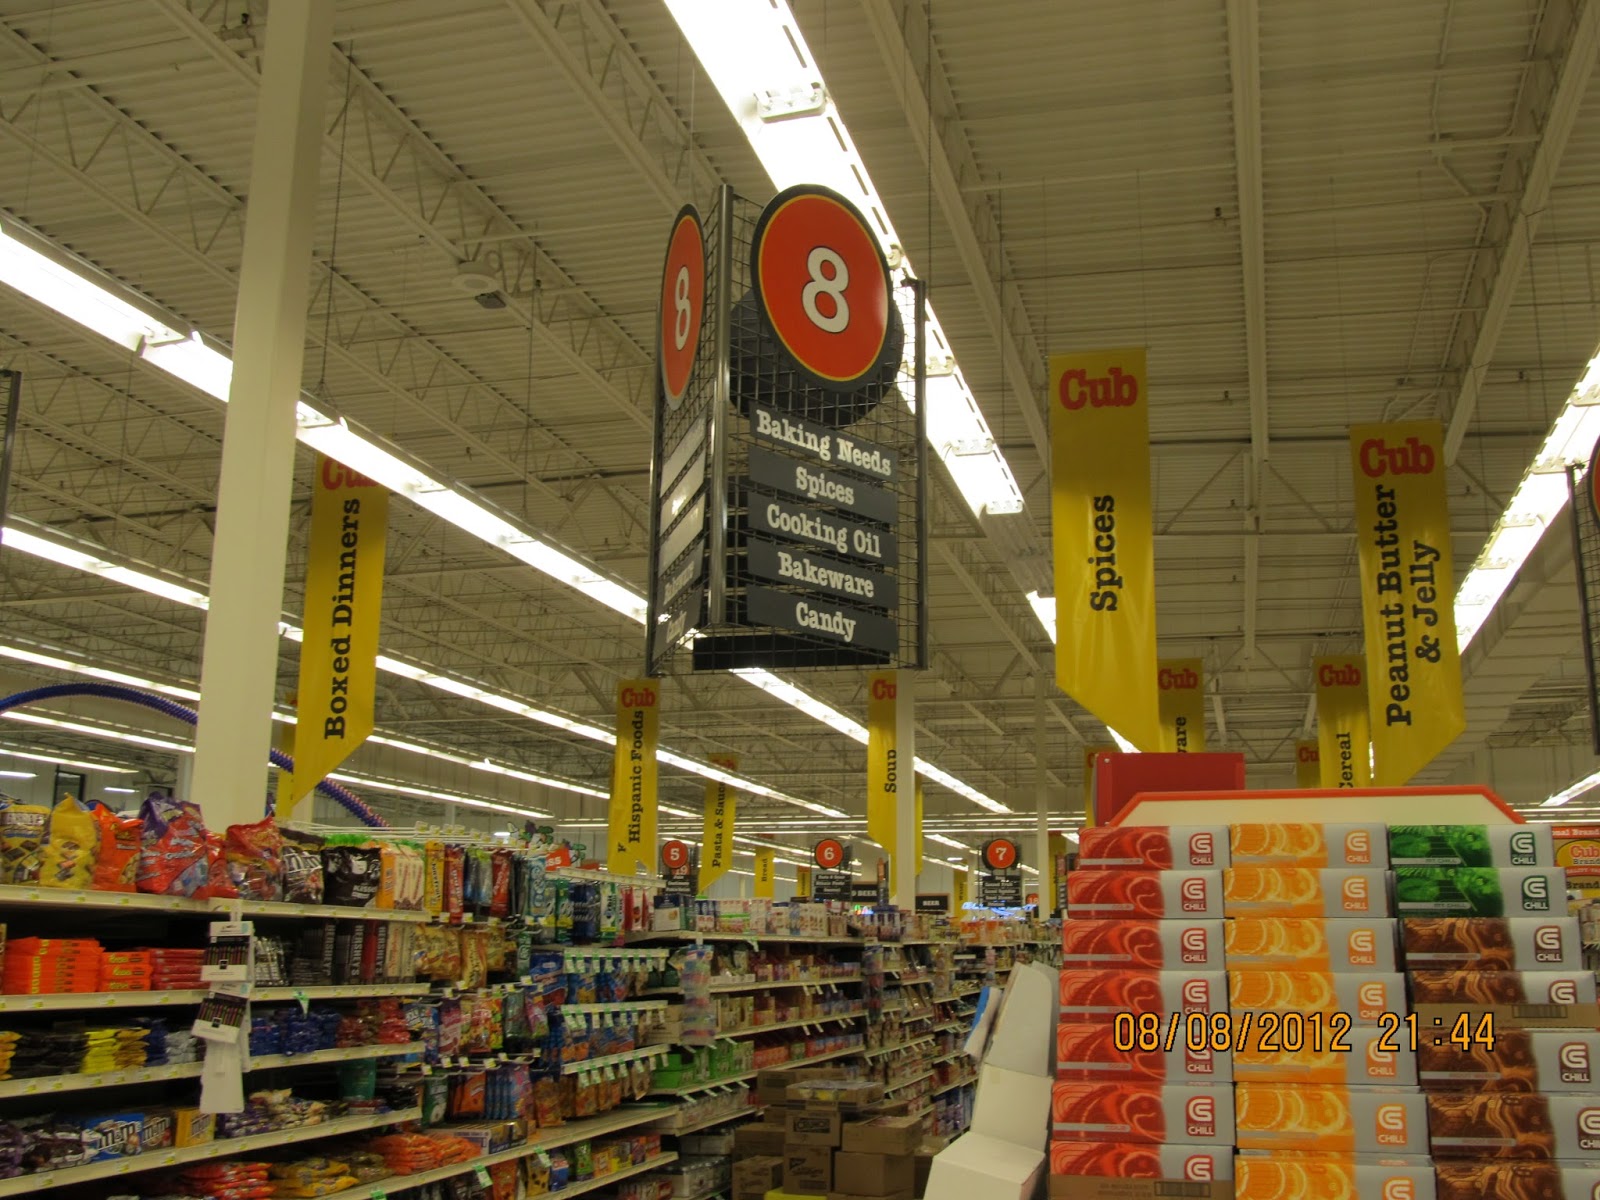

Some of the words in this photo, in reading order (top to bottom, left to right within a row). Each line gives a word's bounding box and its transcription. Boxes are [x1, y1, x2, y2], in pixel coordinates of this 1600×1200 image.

[802, 246, 850, 334] 8
[674, 265, 692, 351] 8
[1058, 366, 1139, 411] Cub
[756, 409, 831, 461] Baking
[836, 437, 892, 476] Needs
[1359, 436, 1436, 478] Cub
[795, 466, 855, 506] Spices
[766, 503, 849, 554] Cooking
[853, 528, 882, 559] Oil
[1373, 484, 1403, 596] Butter
[332, 498, 361, 628] Dinners
[1087, 494, 1123, 612] Spices
[777, 551, 875, 598] Bakeware
[1409, 539, 1441, 628] Jelly
[795, 601, 857, 643] Candy
[1415, 633, 1441, 664] &
[1318, 663, 1361, 687] Cub
[1379, 602, 1412, 727] Peanut
[324, 634, 351, 740] Boxed
[872, 679, 897, 700] Cu
[1158, 667, 1199, 690] Cub
[621, 687, 656, 708] Cub
[631, 710, 644, 763] Foods
[628, 765, 644, 844] Hispanic
[670, 848, 680, 861] 5
[712, 832, 724, 868] Pasta
[824, 847, 835, 861] 6
[996, 847, 1007, 861] 7
[1346, 855, 1369, 863] CHILL
[1570, 845, 1600, 858] Cub
[1183, 903, 1206, 911] CHILL
[1344, 902, 1368, 910] CHILL
[1523, 901, 1548, 909] CHILL
[1183, 954, 1207, 962] CHILL
[1350, 955, 1374, 964] CHILL
[1536, 953, 1562, 962] CHILL
[1187, 1063, 1212, 1072] CHILL
[1368, 1066, 1394, 1075] CHILL
[1562, 1072, 1590, 1082] CHILL
[1188, 1126, 1214, 1135] CHILL
[1378, 1134, 1405, 1144] CHILL
